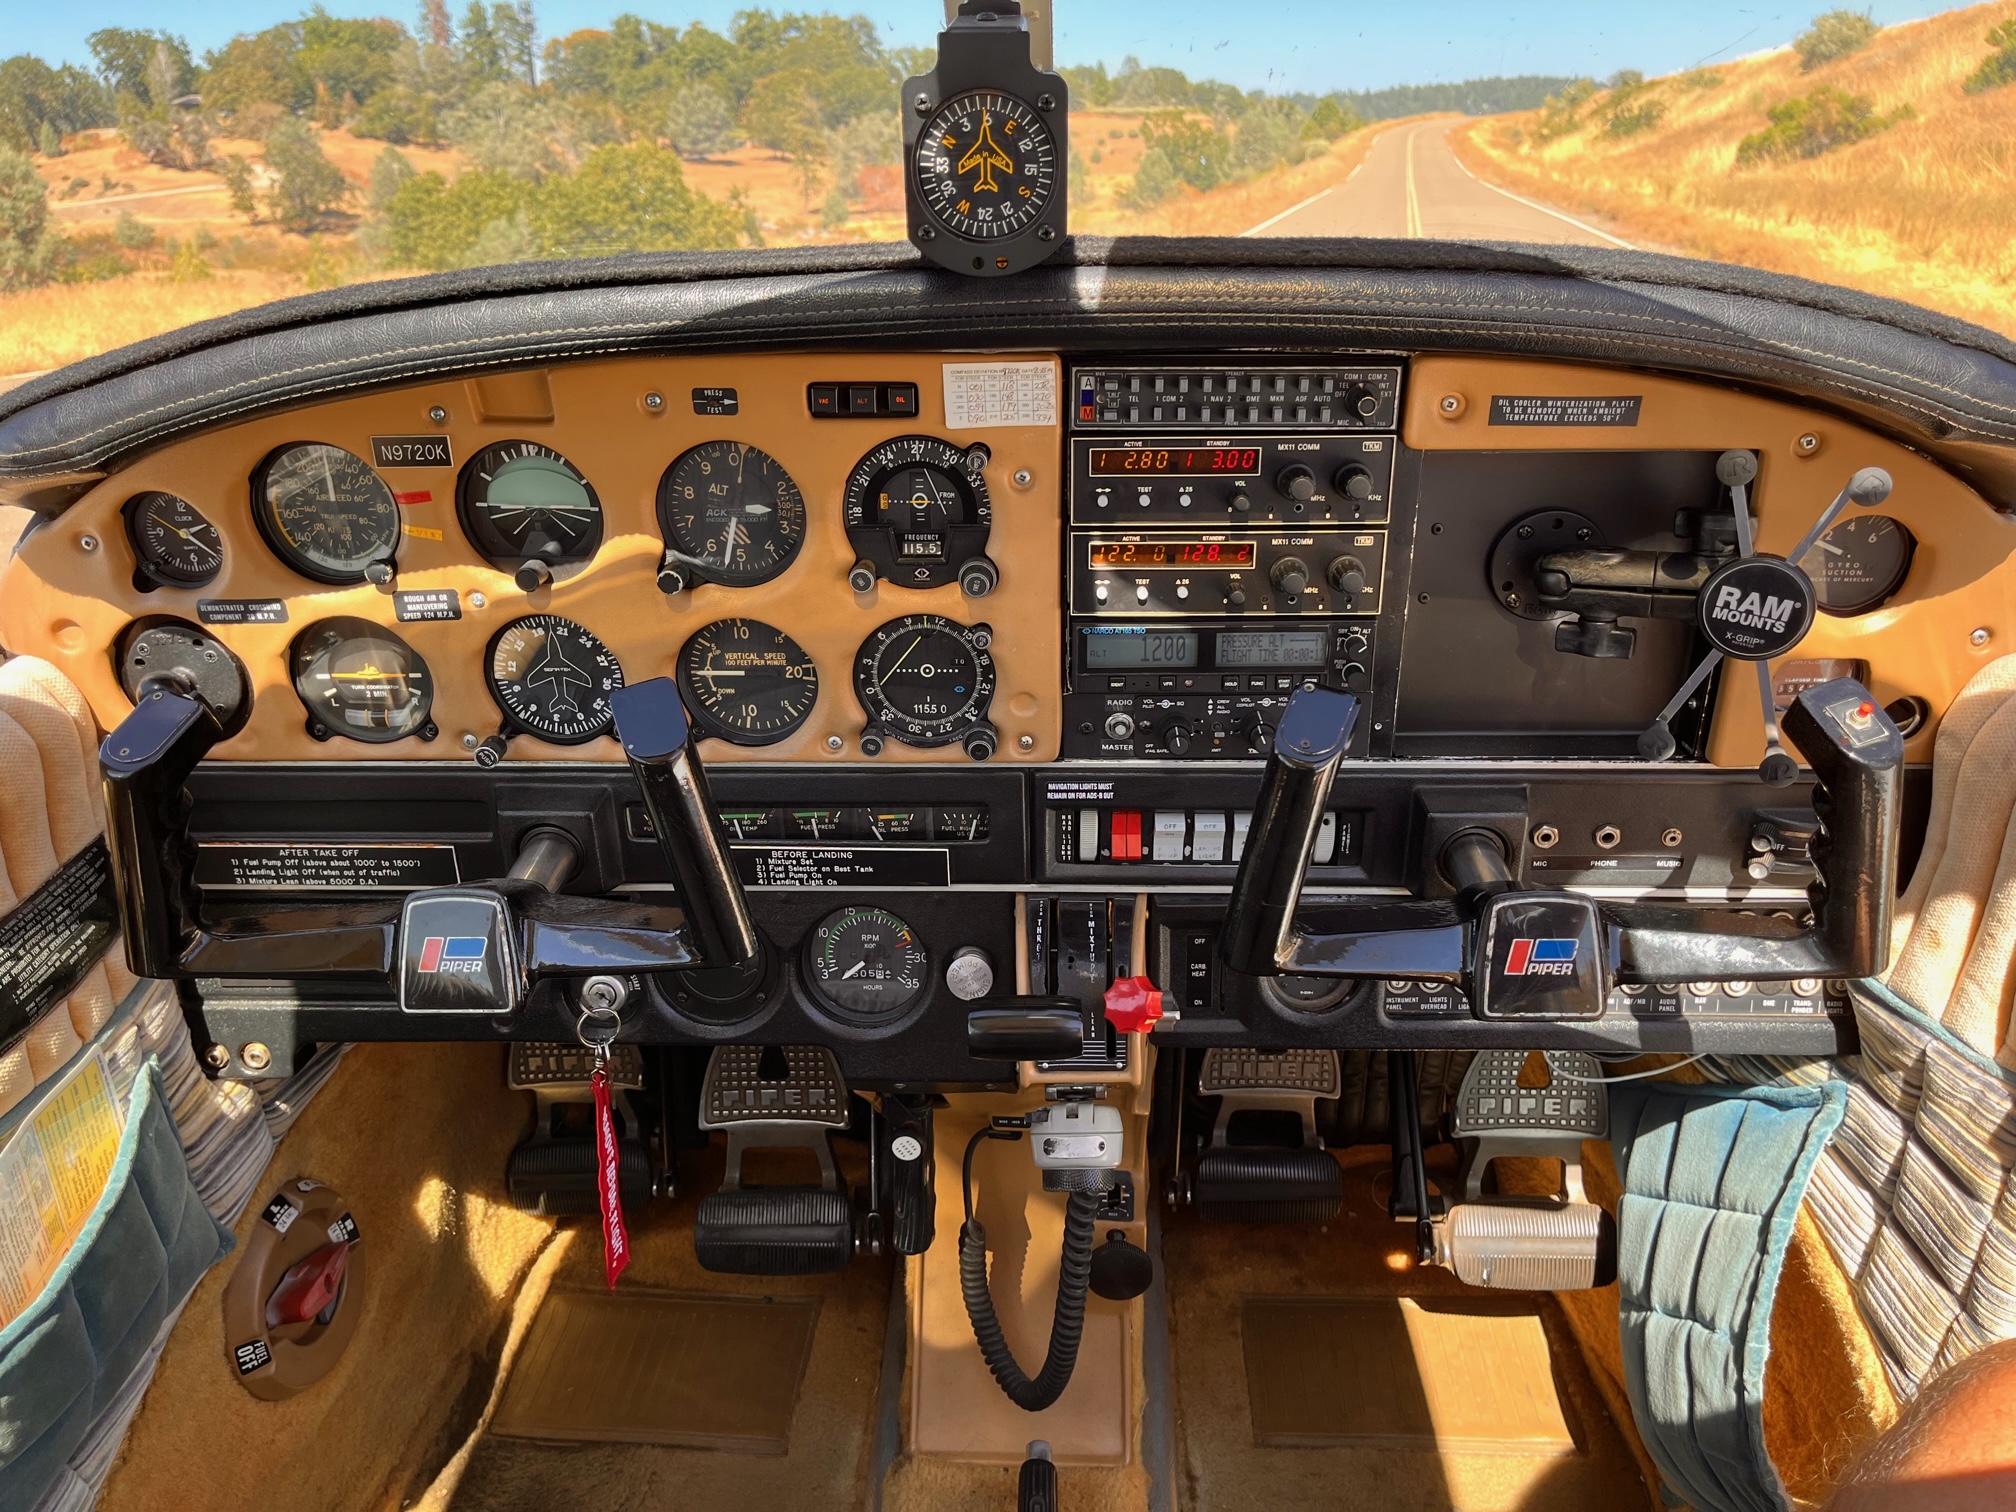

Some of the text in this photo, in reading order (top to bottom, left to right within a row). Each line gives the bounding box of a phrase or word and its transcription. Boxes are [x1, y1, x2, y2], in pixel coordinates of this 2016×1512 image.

[937, 157, 949, 173] 33
[992, 154, 1007, 167] USA
[1025, 164, 1037, 175] 15
[978, 207, 993, 220] 24
[381, 444, 447, 461] N9720K
[911, 444, 924, 454] 27
[345, 464, 358, 474] 40
[359, 476, 372, 485] 60
[708, 483, 729, 496] ALT
[176, 502, 186, 512] 12
[376, 504, 389, 512] 80
[904, 544, 937, 554] 115.5
[1712, 607, 1786, 634] MOUNTS
[1222, 634, 1284, 648] PRESSURE ALT
[1141, 636, 1186, 661] 1200
[1221, 649, 1278, 663] FLIGHT TIME
[786, 666, 802, 678] 20
[742, 705, 757, 716] 10
[818, 928, 828, 938] 10
[32, 948, 50, 968] CATEGORY
[440, 960, 483, 973] PIPER
[1527, 963, 1573, 975] PIPER
[905, 979, 919, 988] 35
[723, 1090, 826, 1107] PIPER
[1479, 1098, 1587, 1115] PIPER
[237, 1345, 258, 1370] OFF
[254, 1341, 268, 1364] FUEL
